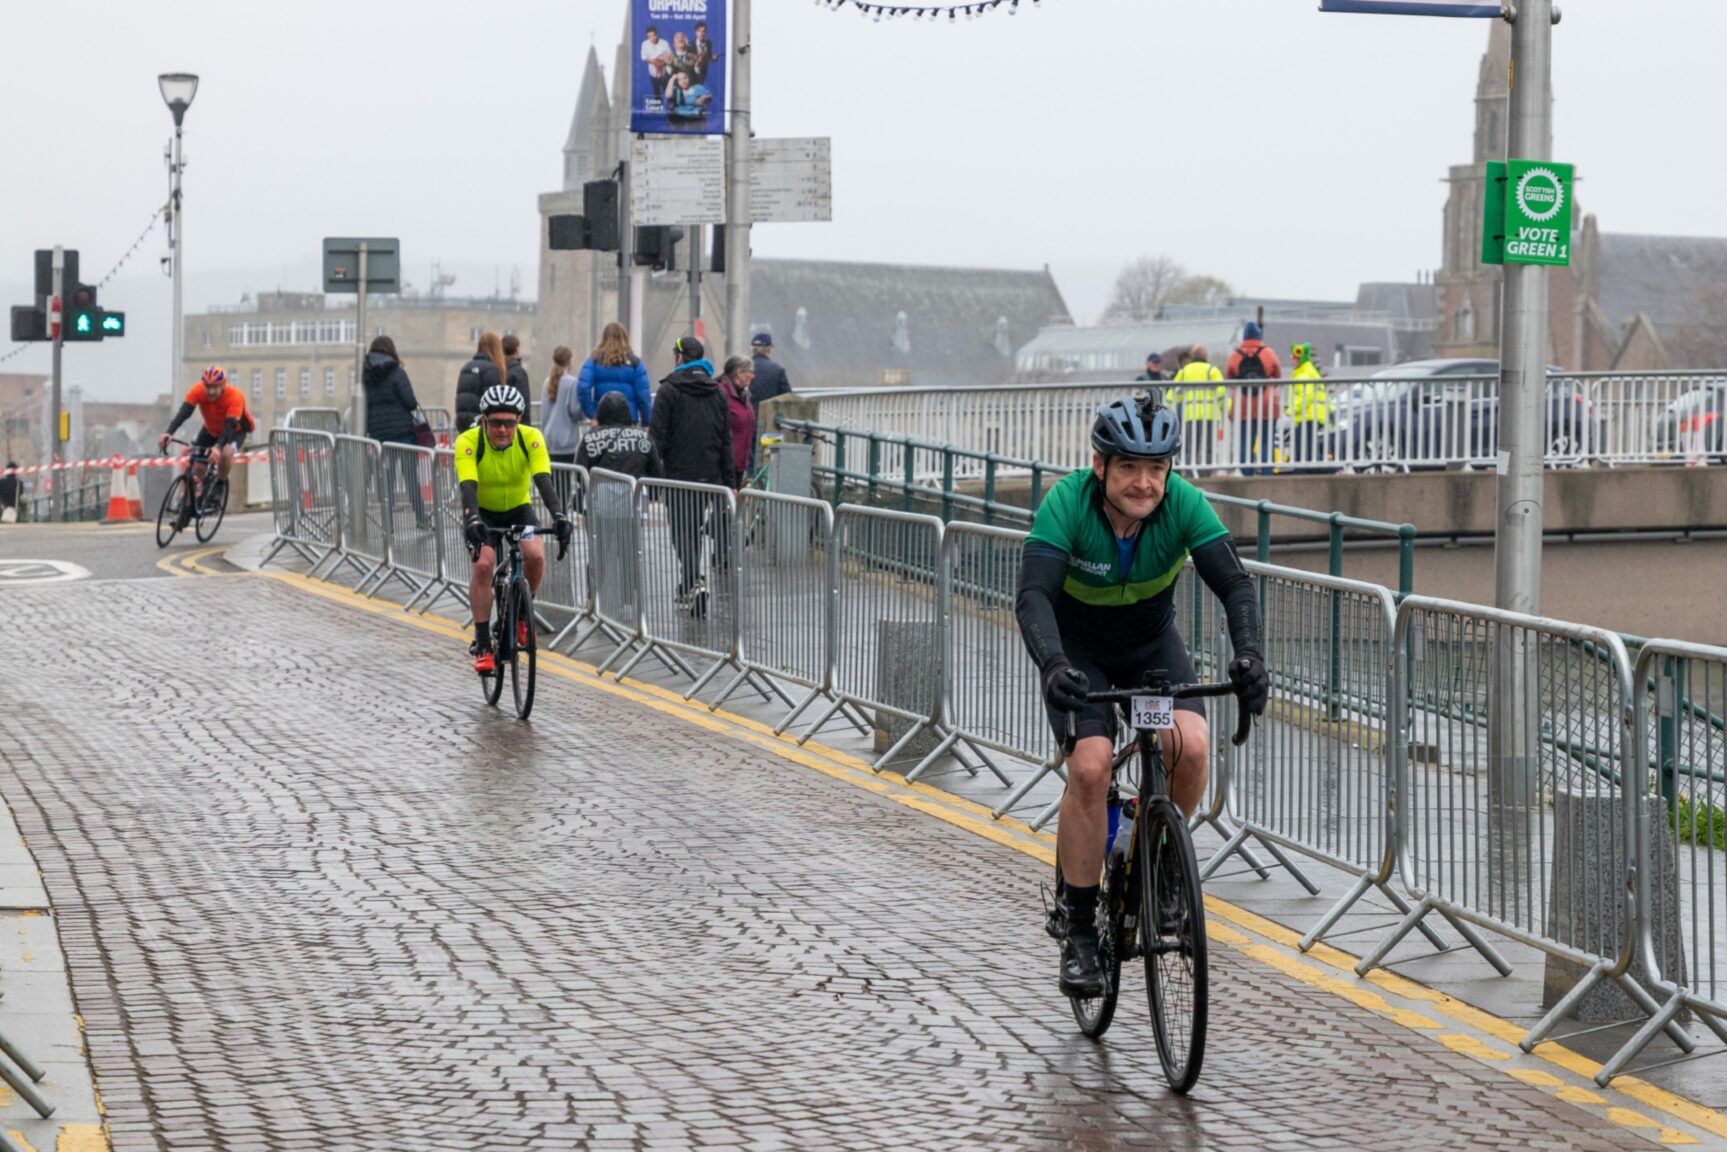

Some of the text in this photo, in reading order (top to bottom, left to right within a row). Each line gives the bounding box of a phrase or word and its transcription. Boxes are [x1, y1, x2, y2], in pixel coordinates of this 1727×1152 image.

[649, 0, 707, 12] ORPHANS
[1525, 192, 1555, 203] GREENS
[1519, 227, 1559, 242] VOTE
[1507, 241, 1567, 258] GREEN 1
[1136, 712, 1170, 725] 1355
